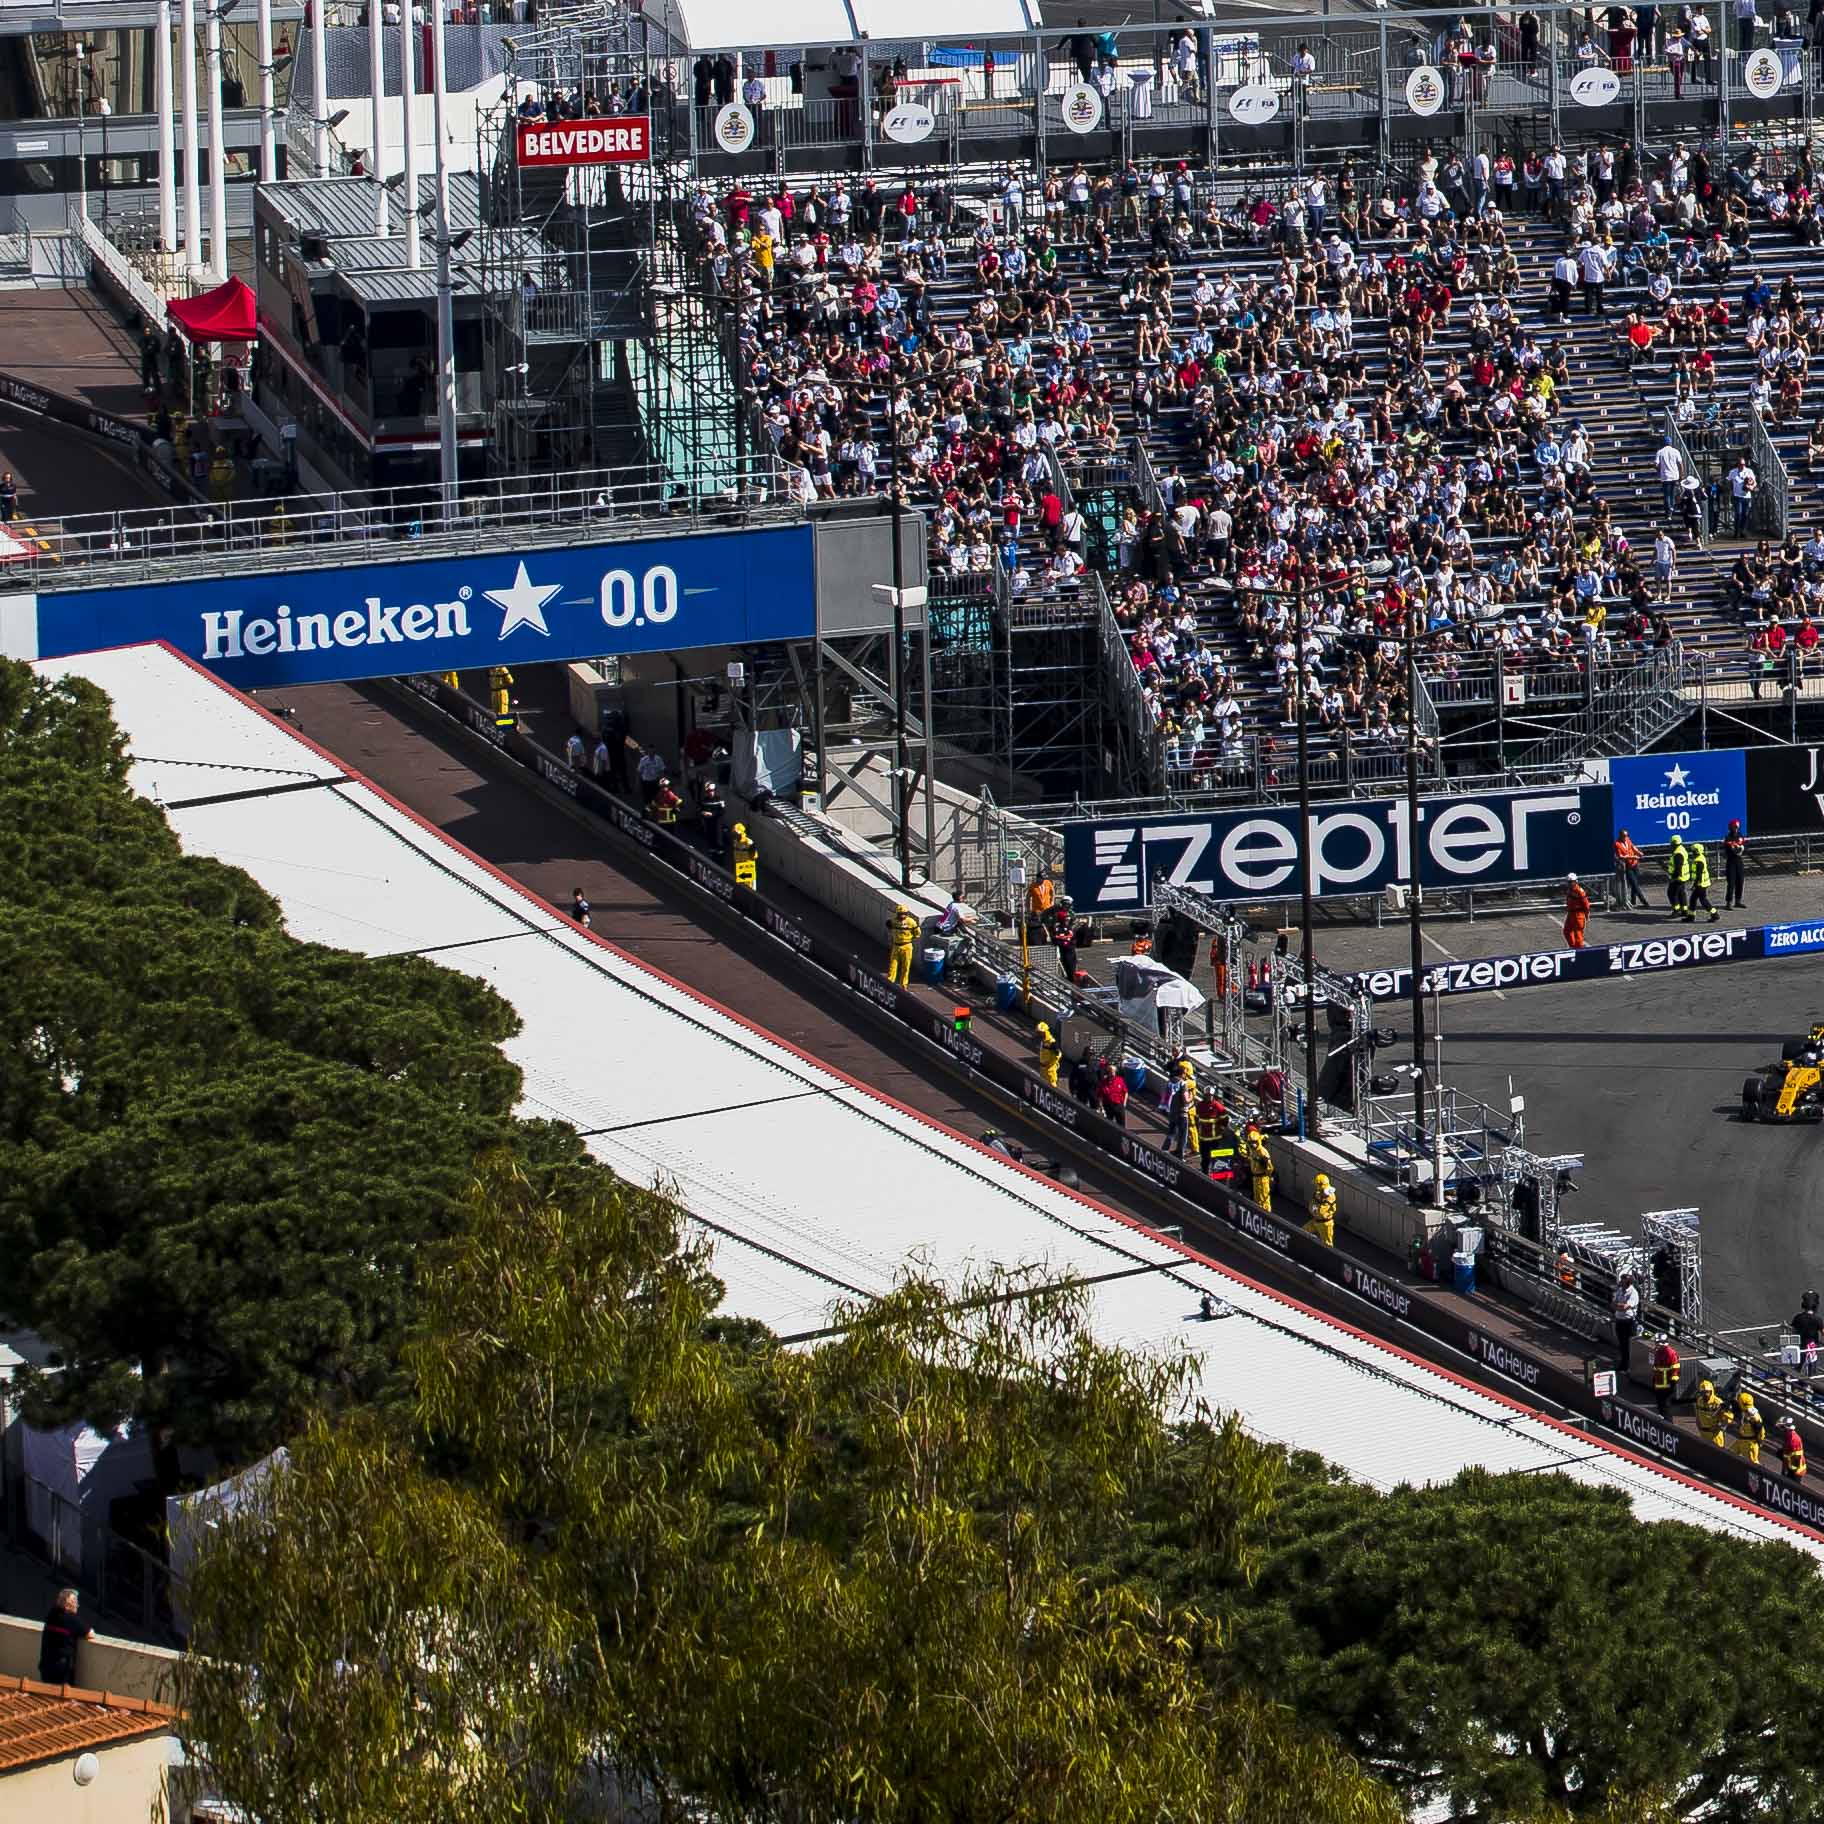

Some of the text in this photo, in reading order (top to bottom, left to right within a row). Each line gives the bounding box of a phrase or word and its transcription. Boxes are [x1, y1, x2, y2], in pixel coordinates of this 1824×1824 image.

[525, 128, 642, 157] BELVEDERE
[201, 565, 678, 659] Heineken 0.0
[1509, 687, 1519, 701] L
[1636, 789, 1719, 810] Heineken
[1666, 812, 1690, 830] 0.0
[1142, 796, 1581, 907] zepter
[1622, 929, 1747, 972] zepter
[1771, 928, 1798, 947] ZERO
[1448, 951, 1575, 1000] zepter
